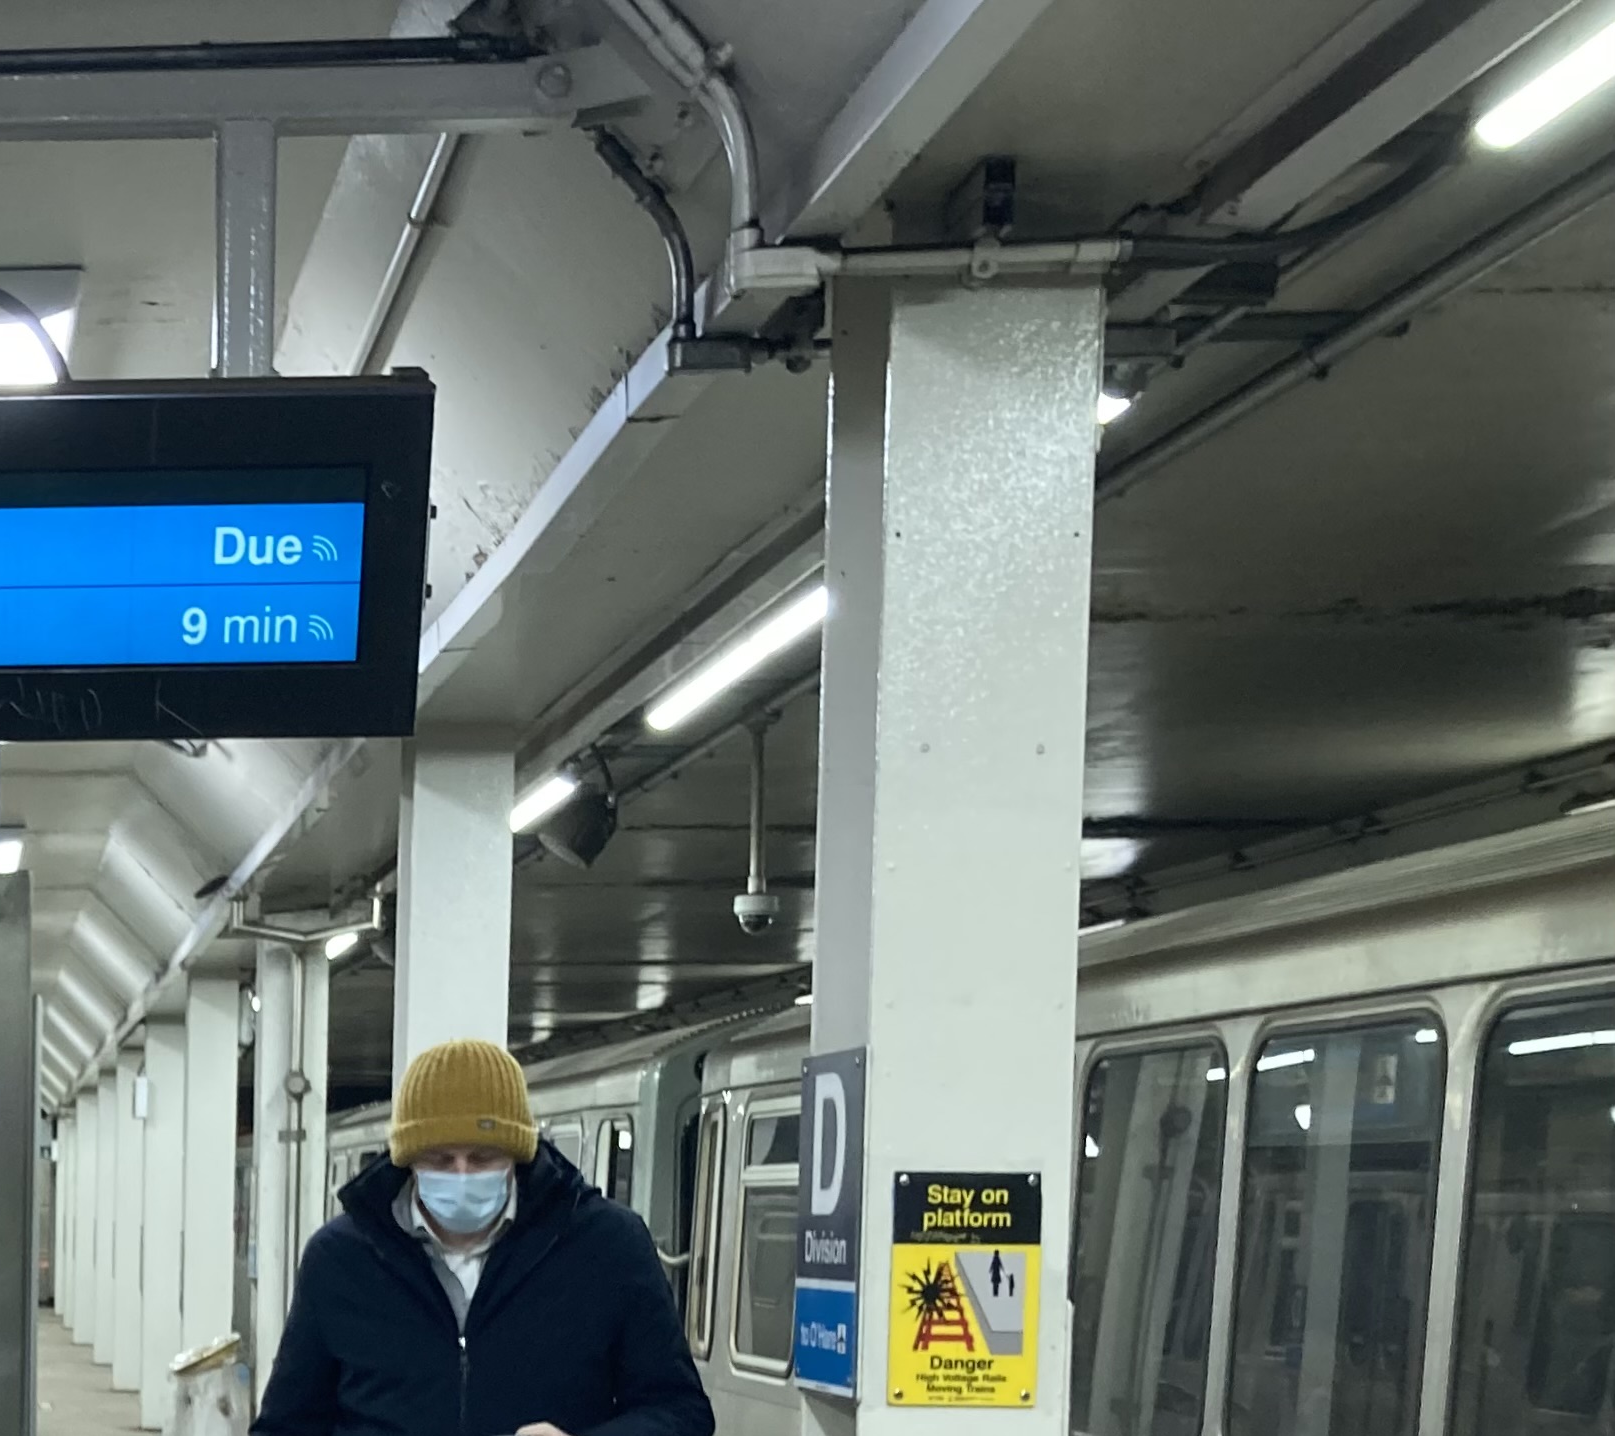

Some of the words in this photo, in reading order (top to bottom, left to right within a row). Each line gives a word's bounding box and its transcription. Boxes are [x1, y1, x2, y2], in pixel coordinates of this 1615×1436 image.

[214, 526, 303, 566] Due
[182, 607, 207, 645] 9
[224, 605, 297, 644] min
[811, 1072, 846, 1216] D
[927, 1183, 975, 1209] Stay
[981, 1188, 1009, 1205] on
[923, 1208, 1011, 1232] platform
[805, 1229, 847, 1264] Division
[930, 1355, 994, 1374] Danger
[926, 1384, 962, 1394] Moving
[967, 1383, 995, 1393] Trains
